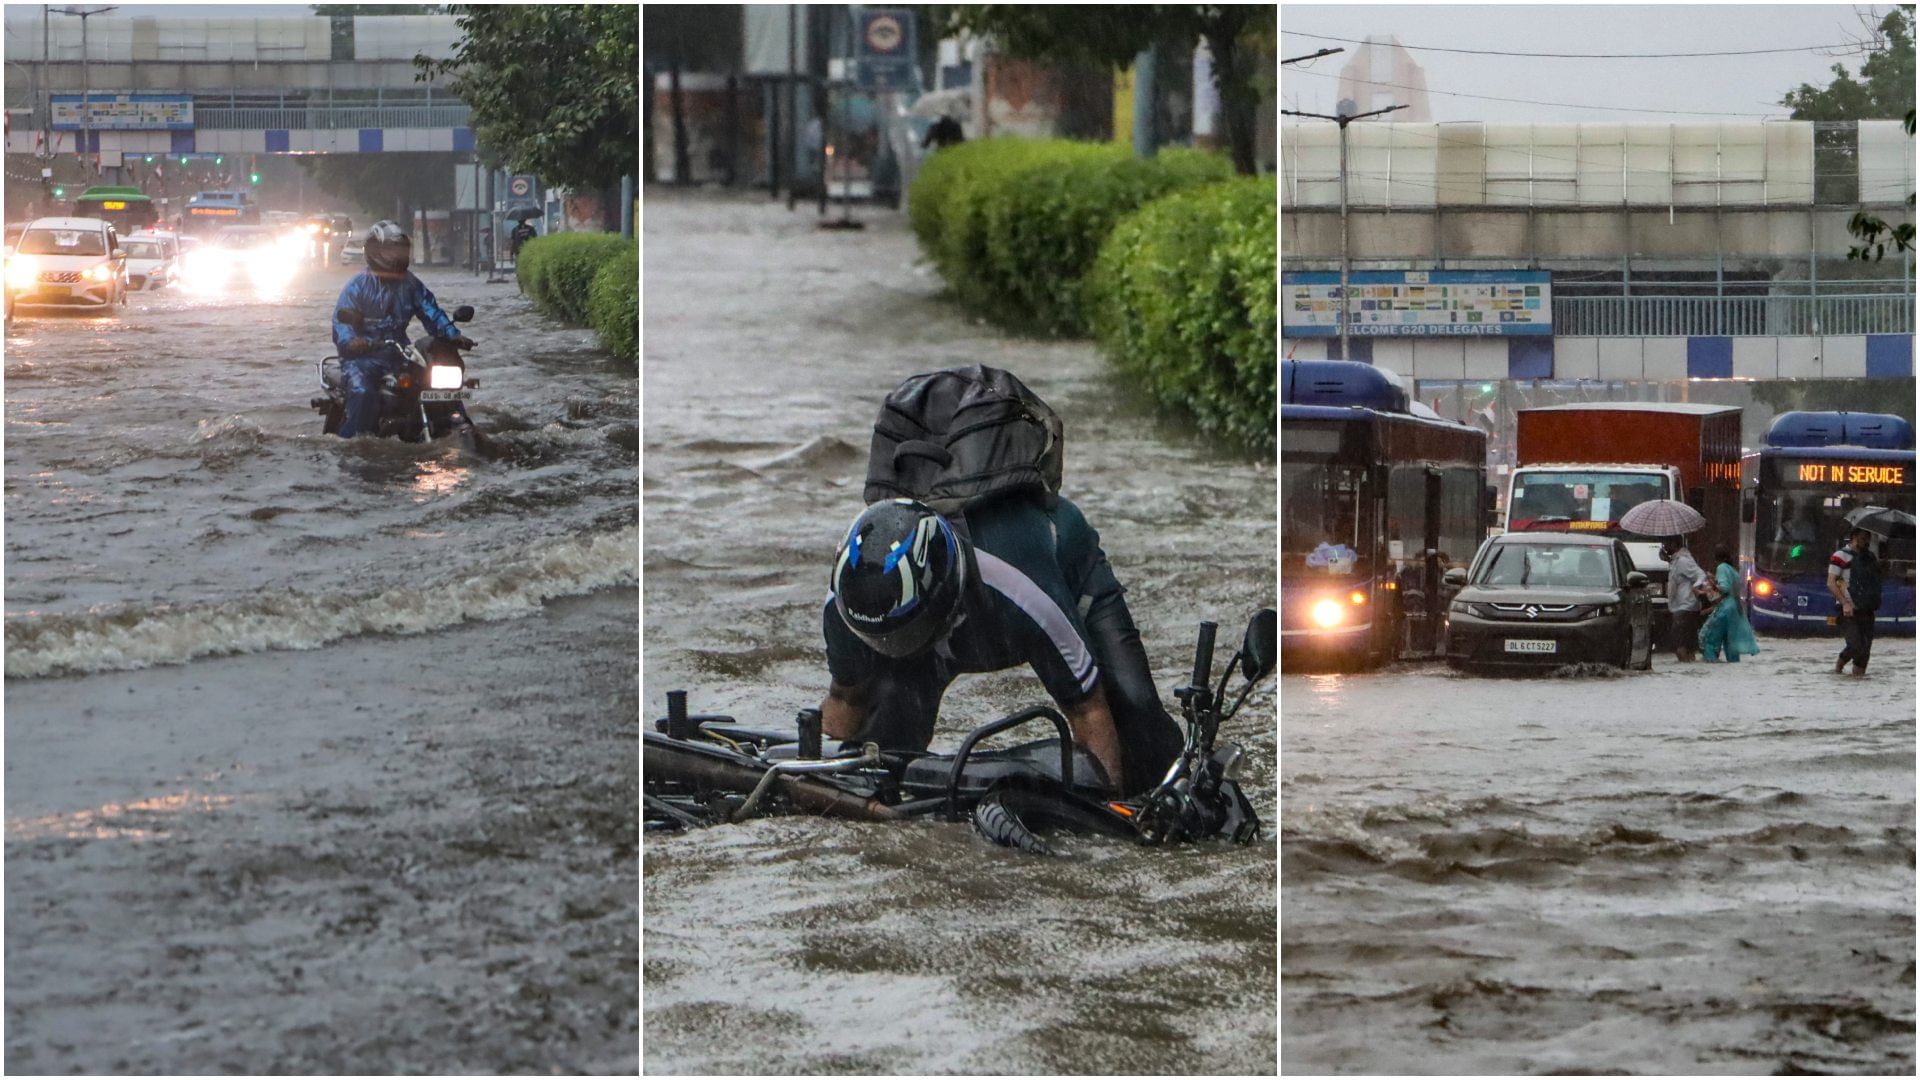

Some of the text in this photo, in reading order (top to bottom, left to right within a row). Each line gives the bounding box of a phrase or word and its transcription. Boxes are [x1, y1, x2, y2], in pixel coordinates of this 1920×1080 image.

[1334, 325, 1503, 335] WELCOME G20 DELEGATES
[1799, 464, 1903, 484] NOT IN SERVICE
